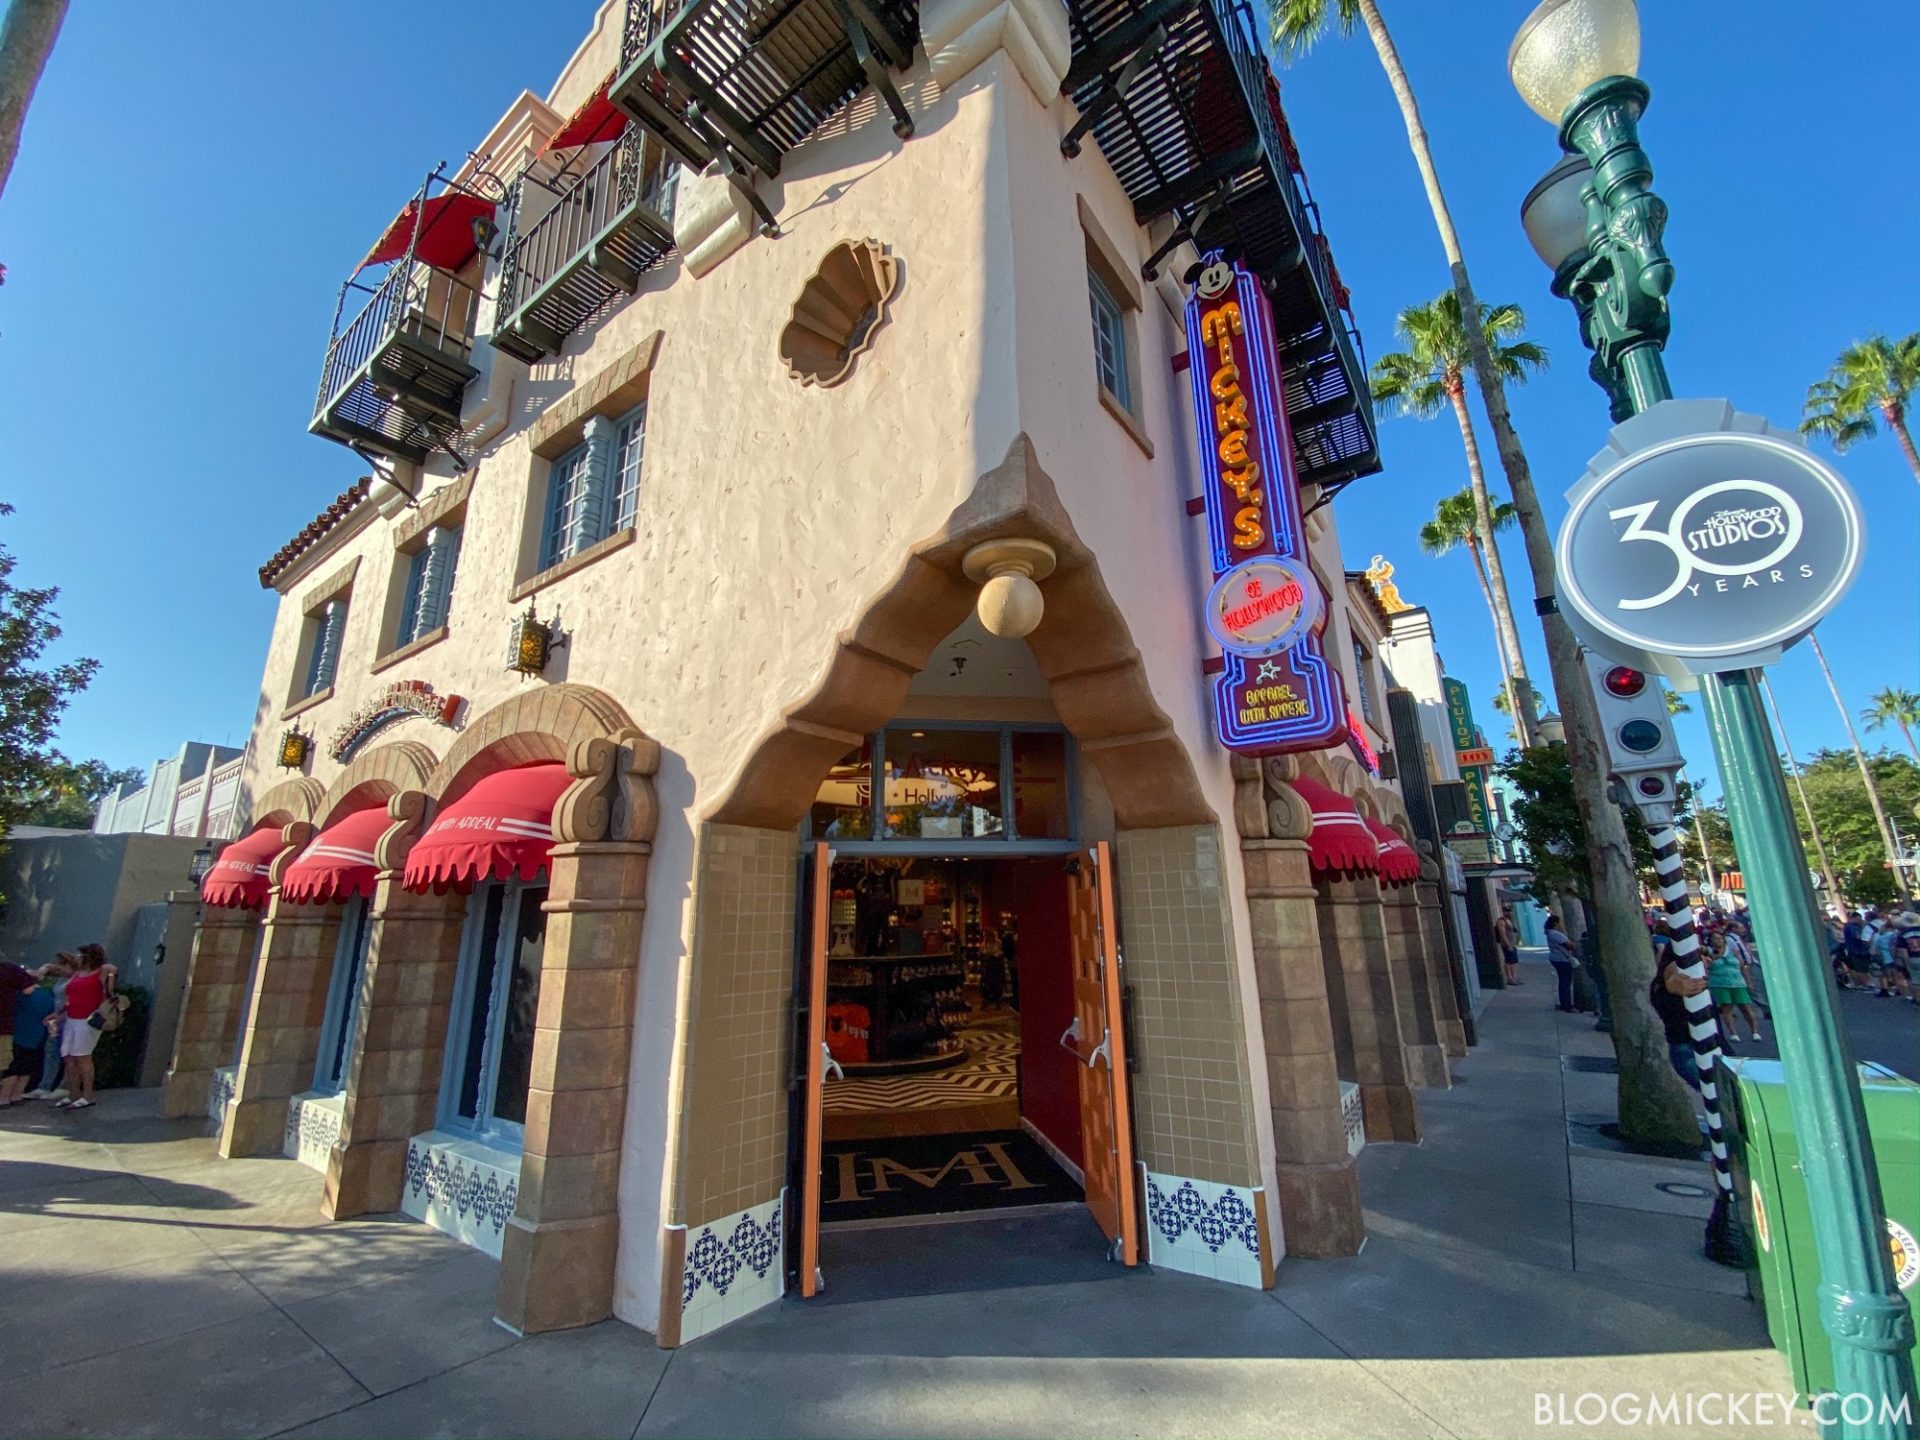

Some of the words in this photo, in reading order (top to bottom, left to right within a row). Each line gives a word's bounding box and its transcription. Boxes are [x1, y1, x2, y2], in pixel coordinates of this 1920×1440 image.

[1201, 301, 1266, 550] MICKEY'S
[1703, 506, 1782, 529] HOLLYWOOD
[1608, 479, 1804, 611] 30
[1687, 515, 1786, 551] STUDIOS
[1686, 564, 1814, 597] YEARS
[1222, 581, 1304, 631] HOLLYWOOD
[1246, 684, 1297, 706] APPAREL
[1269, 699, 1311, 720] APPEAL
[1461, 751, 1489, 763] TOY
[457, 816, 497, 831] APPEAL
[1894, 1229, 1917, 1254] KEEP
